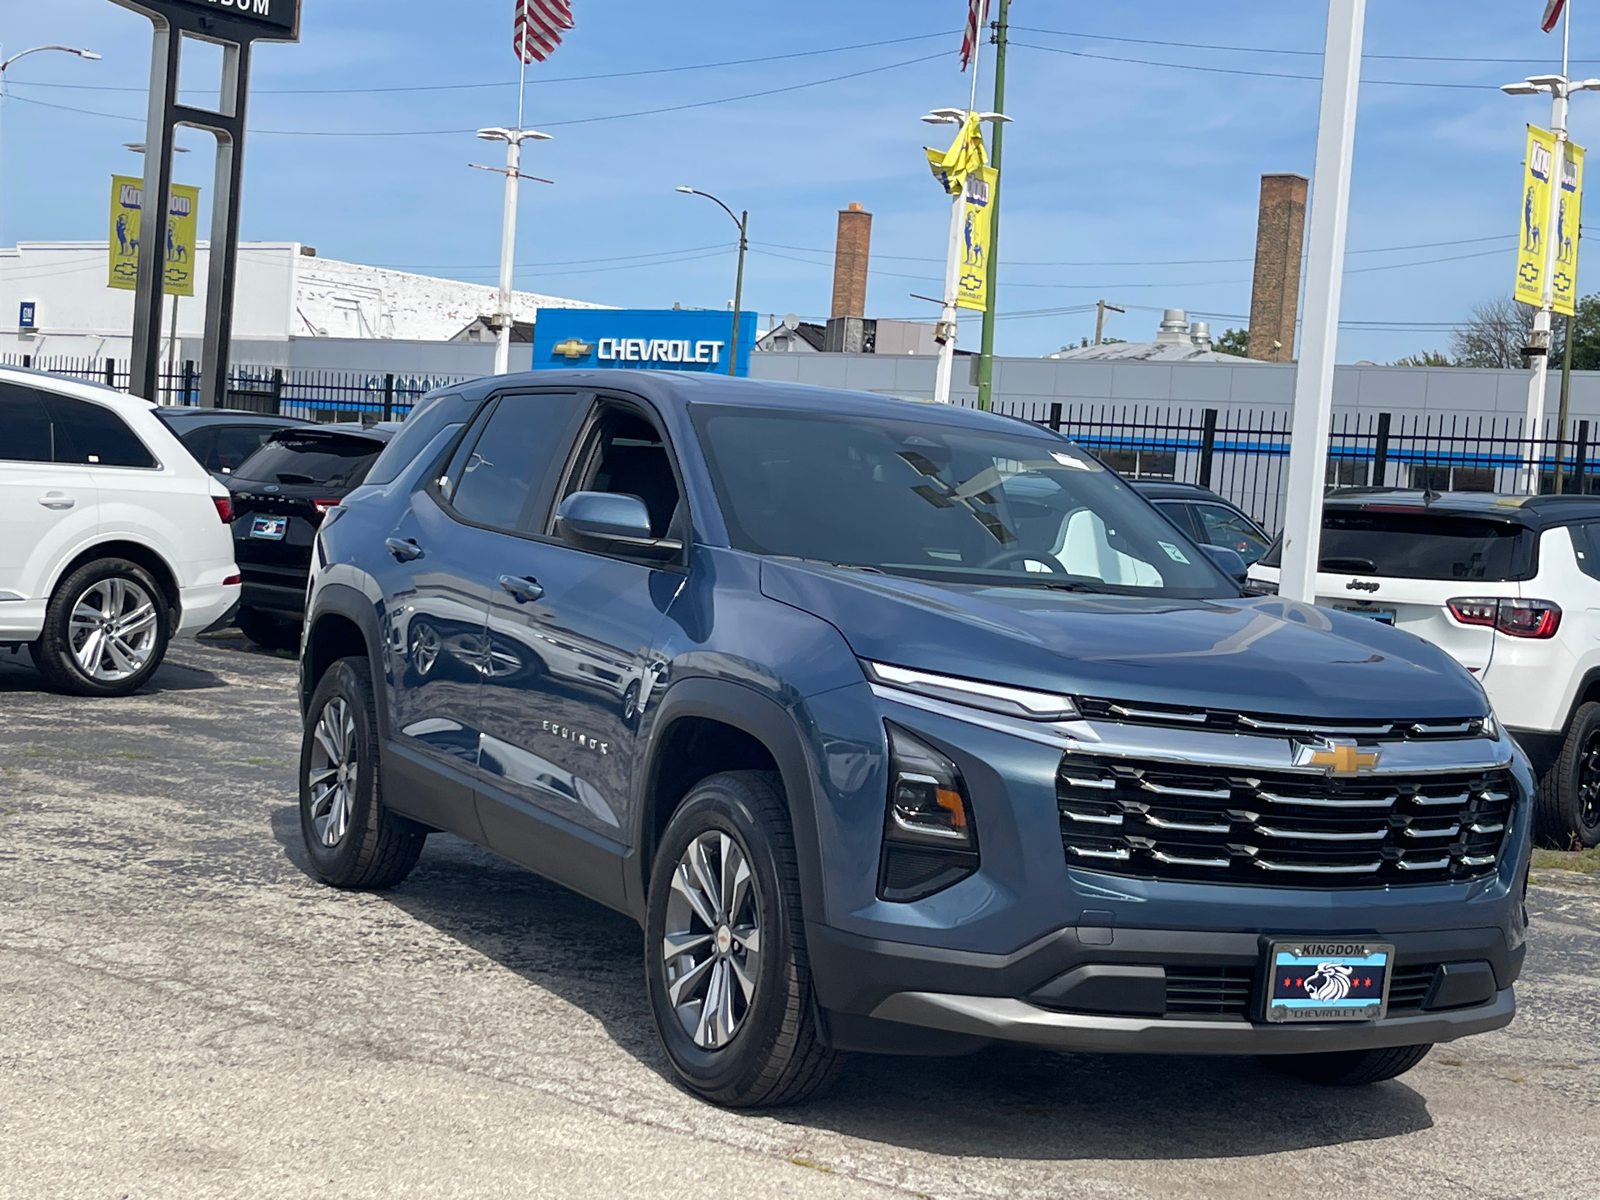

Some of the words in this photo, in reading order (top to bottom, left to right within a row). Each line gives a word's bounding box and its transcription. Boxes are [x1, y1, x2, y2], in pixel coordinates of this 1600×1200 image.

[120, 184, 142, 206] Kin
[598, 338, 725, 363] CHEVROLET
[1346, 579, 1380, 593] Jeep
[543, 720, 608, 754] EQUINOX
[1302, 945, 1365, 955] KINGDOM
[1293, 1009, 1357, 1018] CHEVROLET
